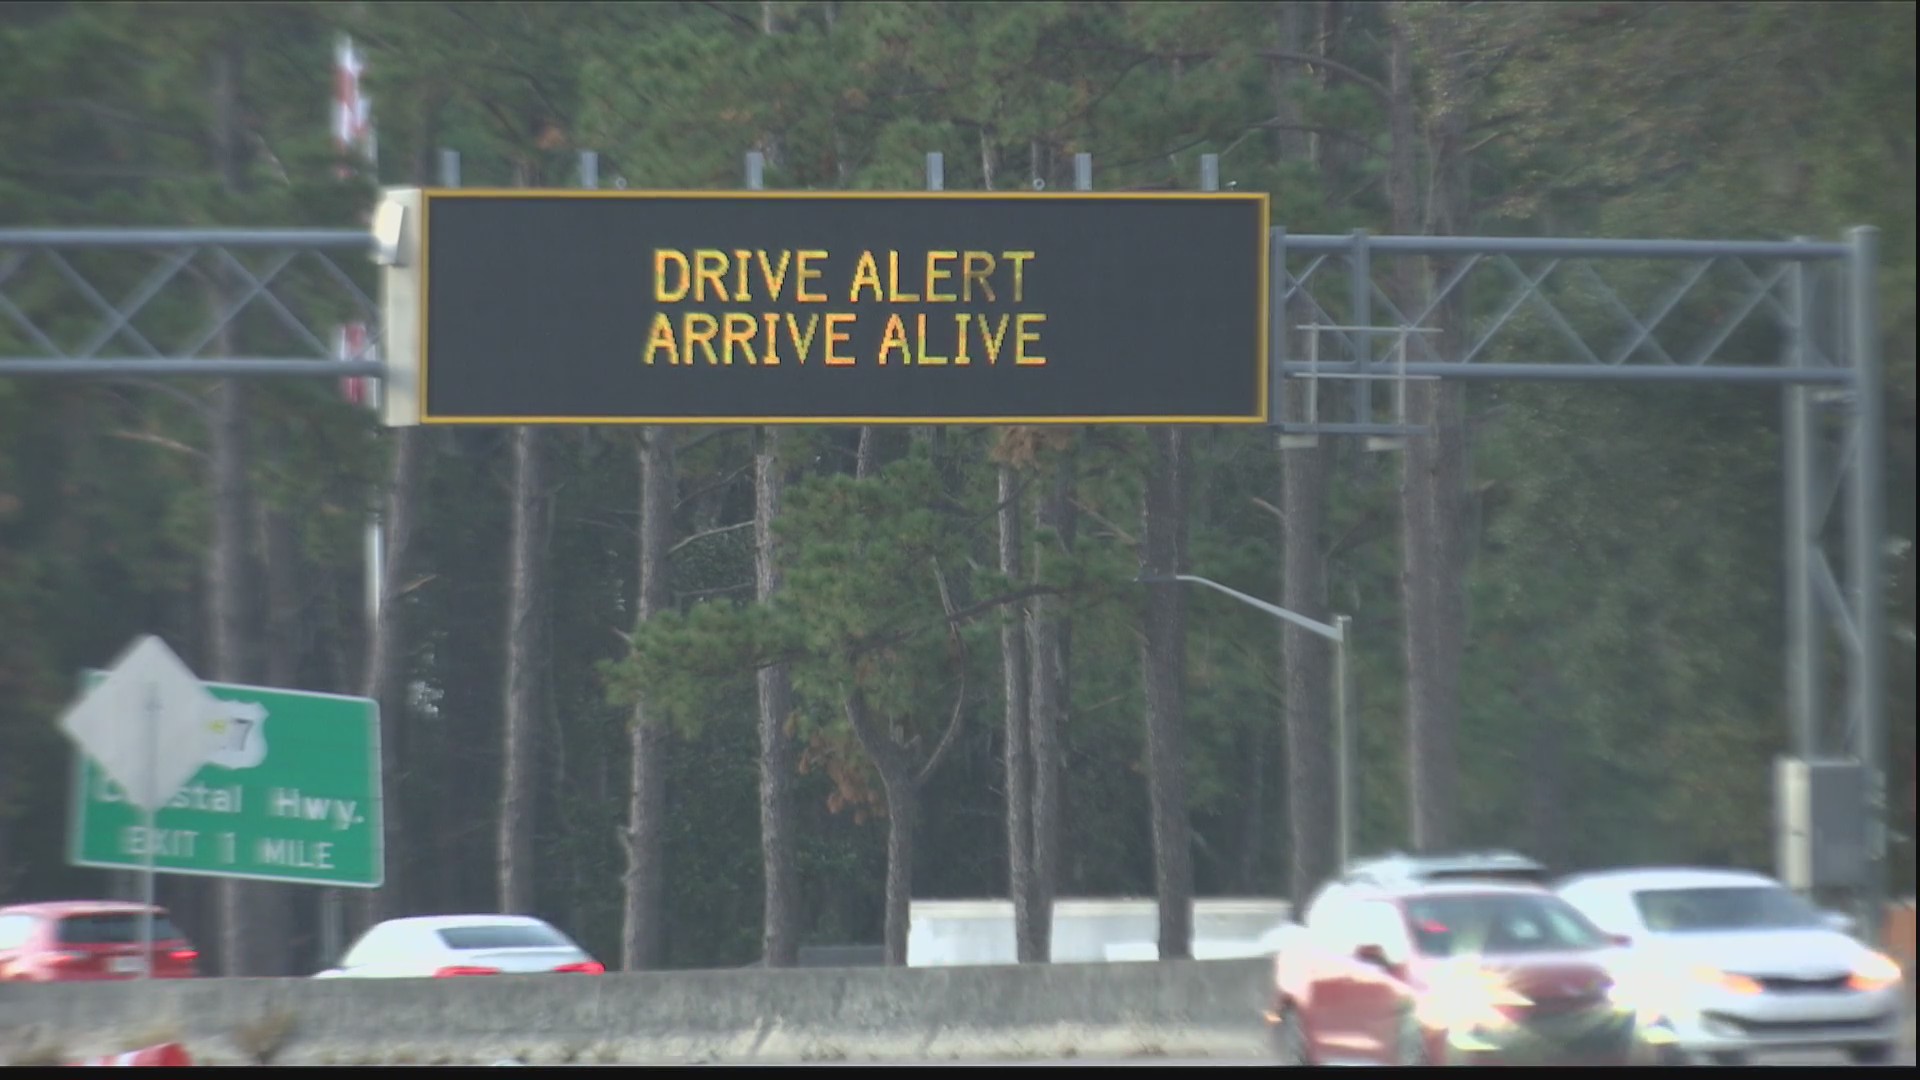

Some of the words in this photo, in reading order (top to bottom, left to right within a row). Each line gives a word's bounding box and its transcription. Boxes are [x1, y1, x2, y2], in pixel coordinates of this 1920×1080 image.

[654, 248, 829, 302] DRIVE
[849, 249, 1036, 302] ALERT
[643, 311, 857, 365] ARRIVE
[878, 312, 1047, 365] ALIVE
[270, 786, 365, 831] Hwy.
[124, 825, 200, 858] EXIT
[216, 831, 236, 864] 1
[259, 837, 336, 869] MILE
